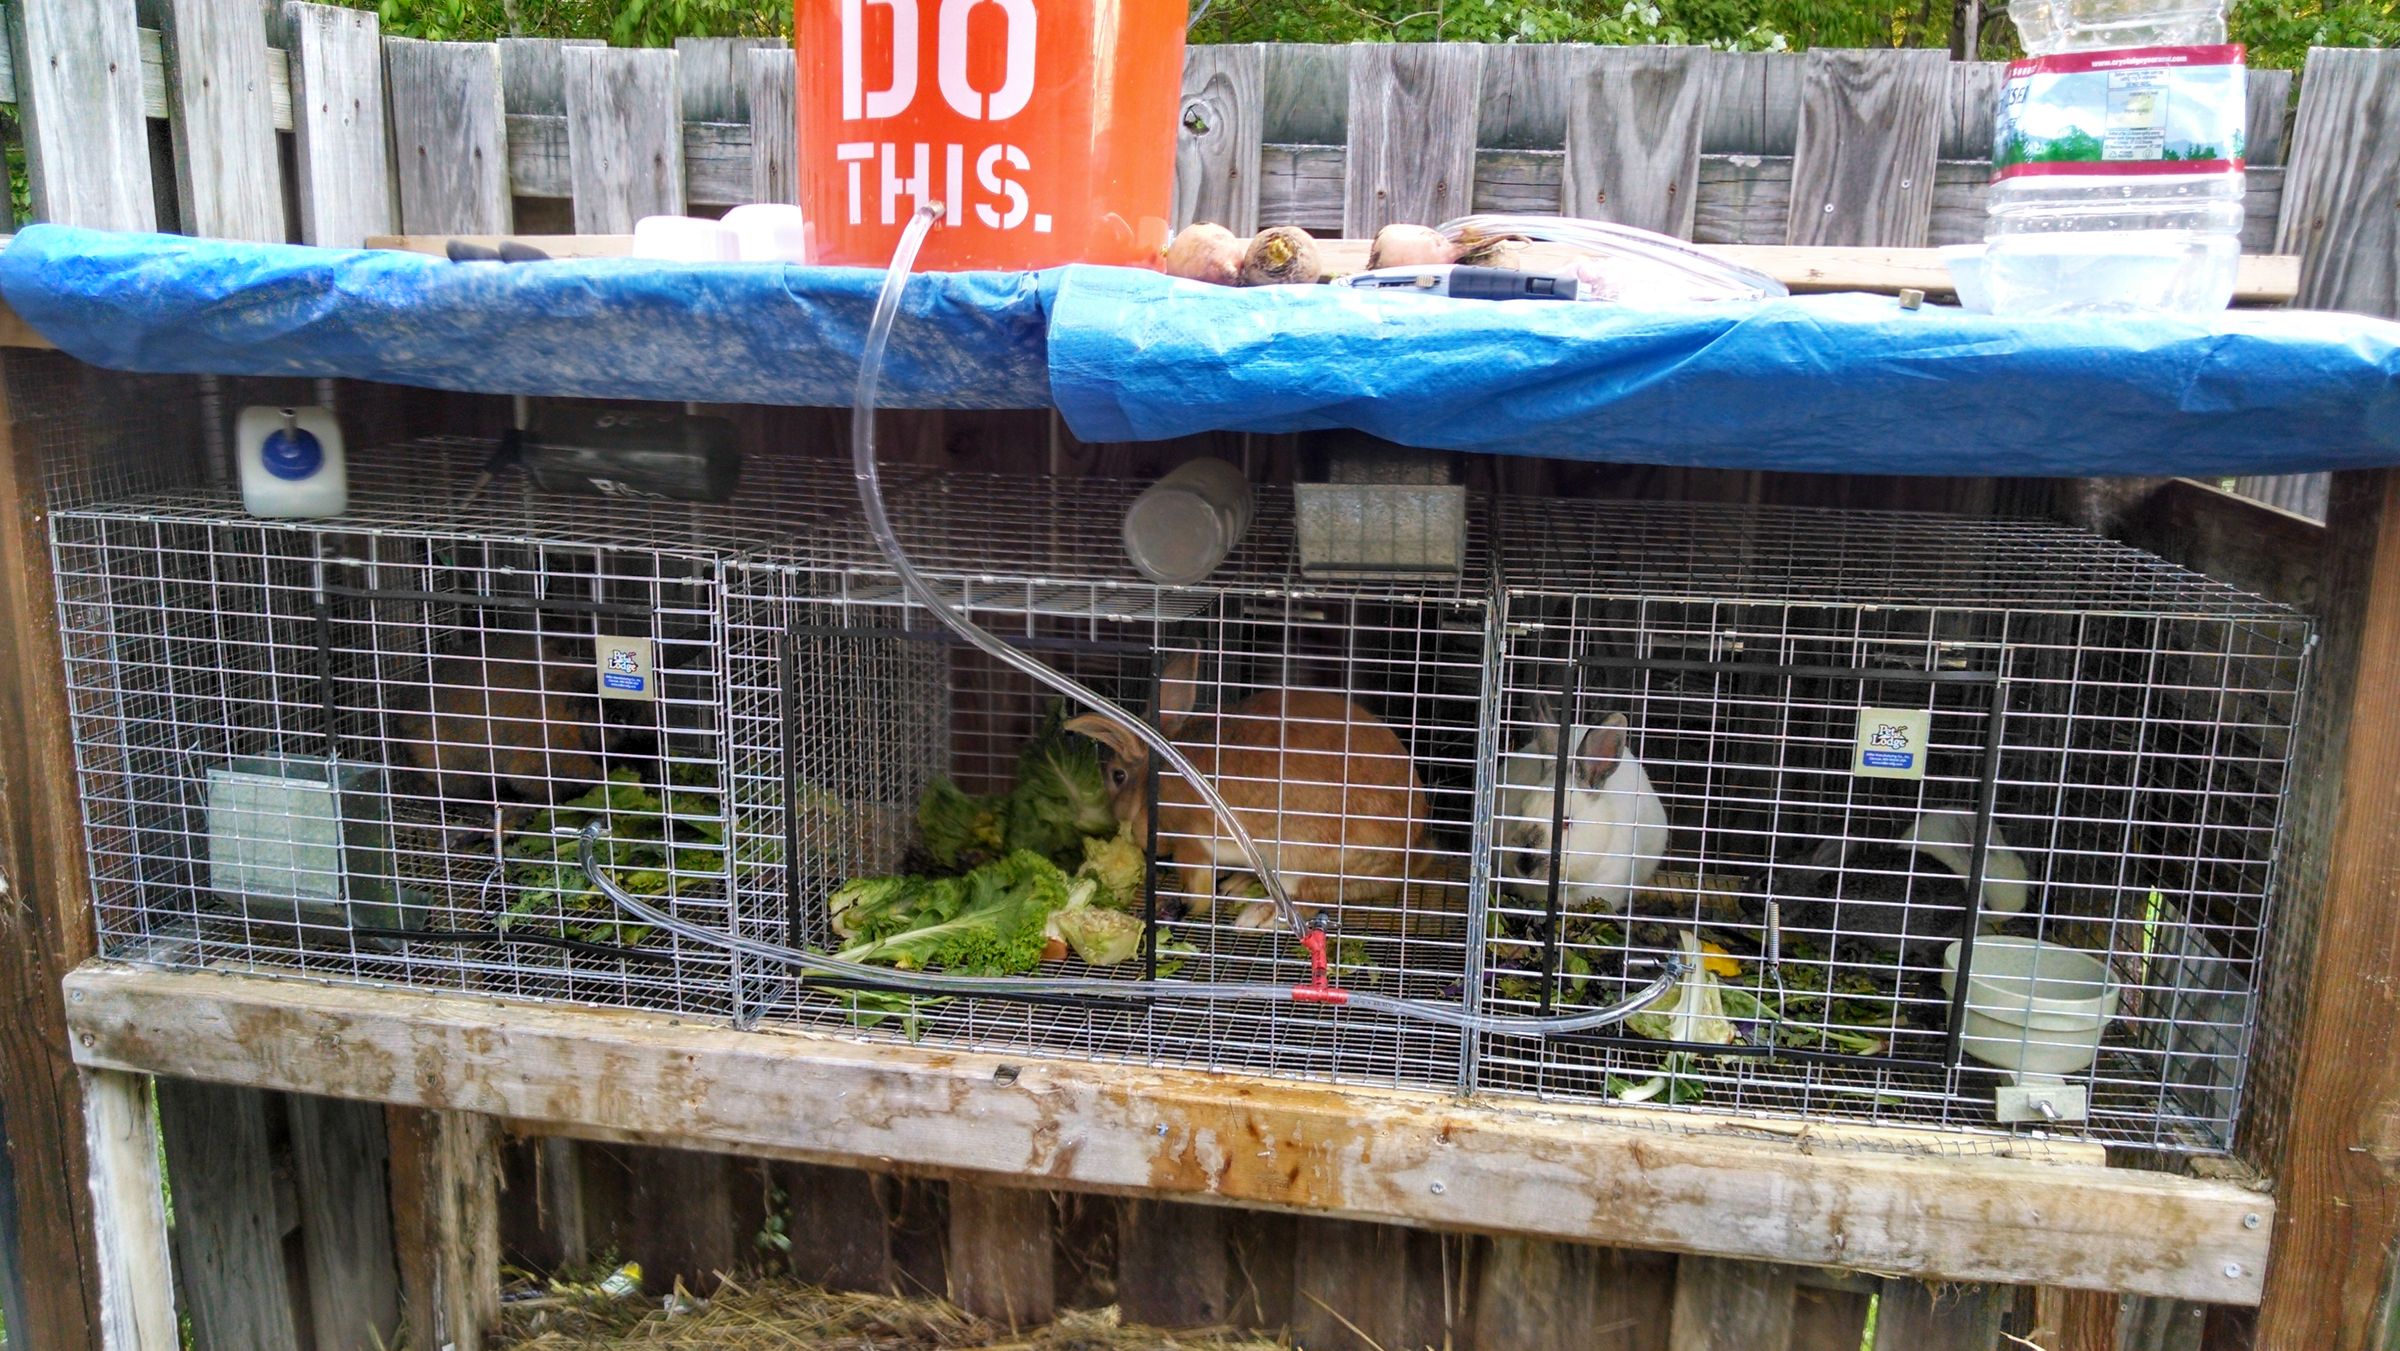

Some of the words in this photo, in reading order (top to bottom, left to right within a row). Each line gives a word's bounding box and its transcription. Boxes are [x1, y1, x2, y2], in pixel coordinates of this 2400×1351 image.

[842, 0, 1037, 121] DO
[837, 142, 1052, 233] THIS.
[613, 649, 627, 661] Pet
[608, 658, 638, 673] Lodge
[1879, 724, 1896, 737] Pet
[1871, 734, 1907, 749] Lodge
